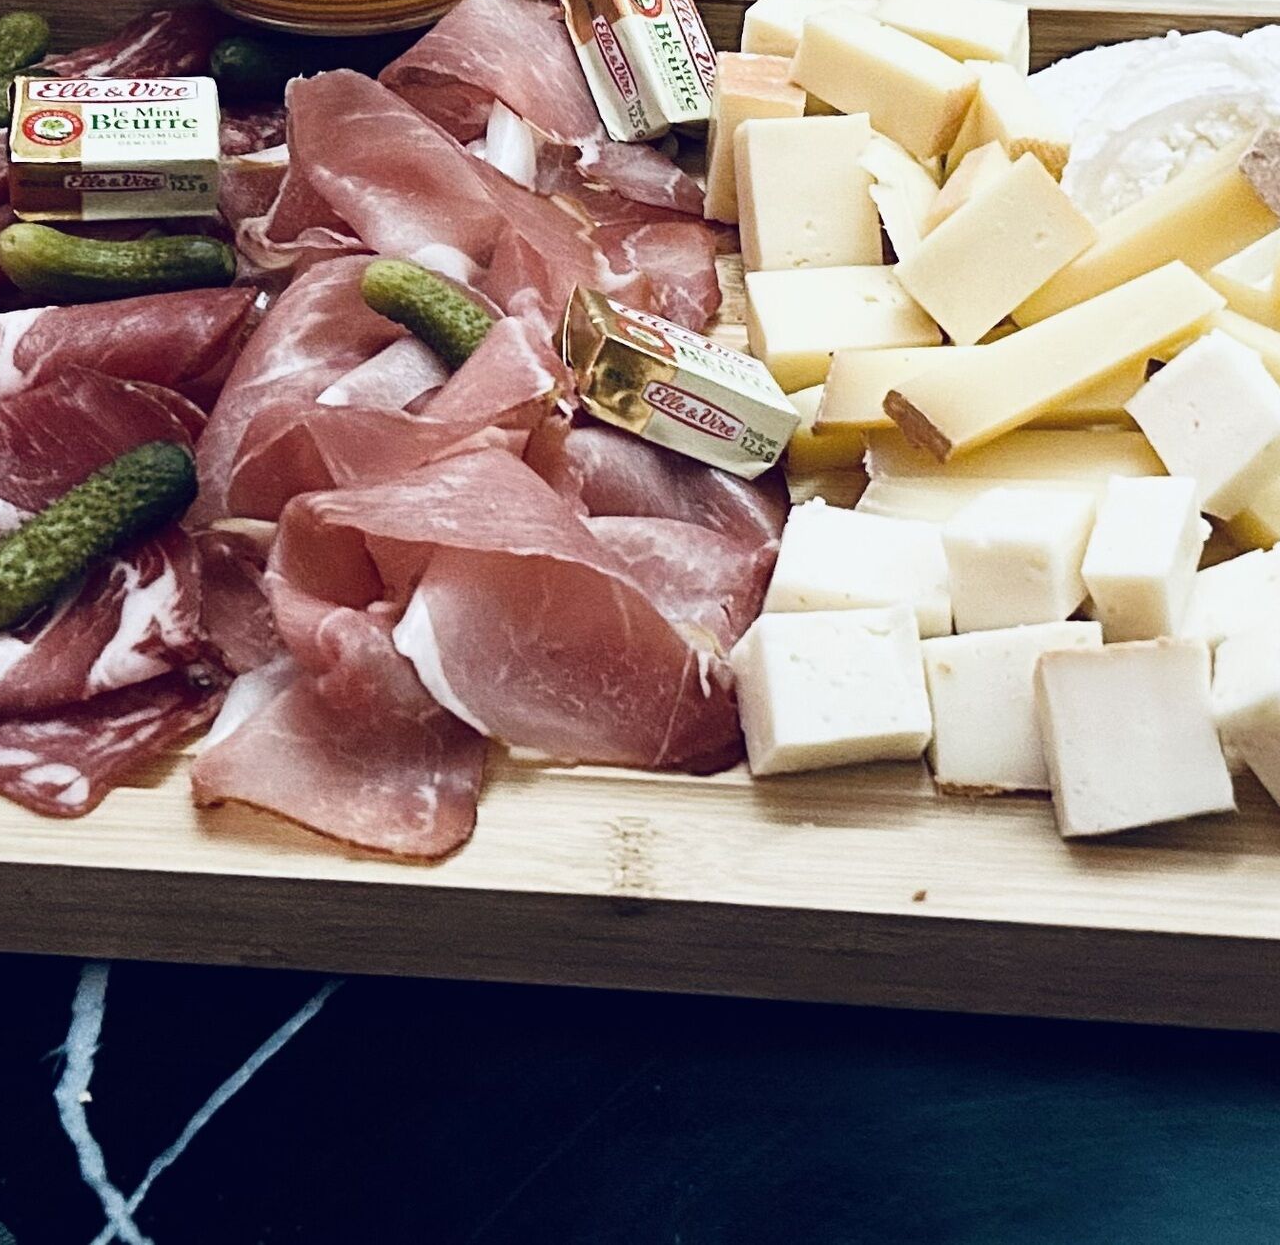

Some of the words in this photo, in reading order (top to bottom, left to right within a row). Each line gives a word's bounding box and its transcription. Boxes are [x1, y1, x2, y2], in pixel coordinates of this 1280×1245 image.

[595, 21, 614, 55] Elle
[614, 62, 633, 98] Vire
[653, 21, 698, 111] Beurre
[36, 82, 99, 98] Elle
[104, 85, 123, 97] &
[128, 82, 189, 97] Vire
[91, 114, 198, 130] Beurre
[113, 107, 128, 117] le
[136, 106, 180, 117] Mini
[648, 386, 686, 413] Elle
[685, 407, 698, 421] &
[699, 407, 736, 437] Vire
